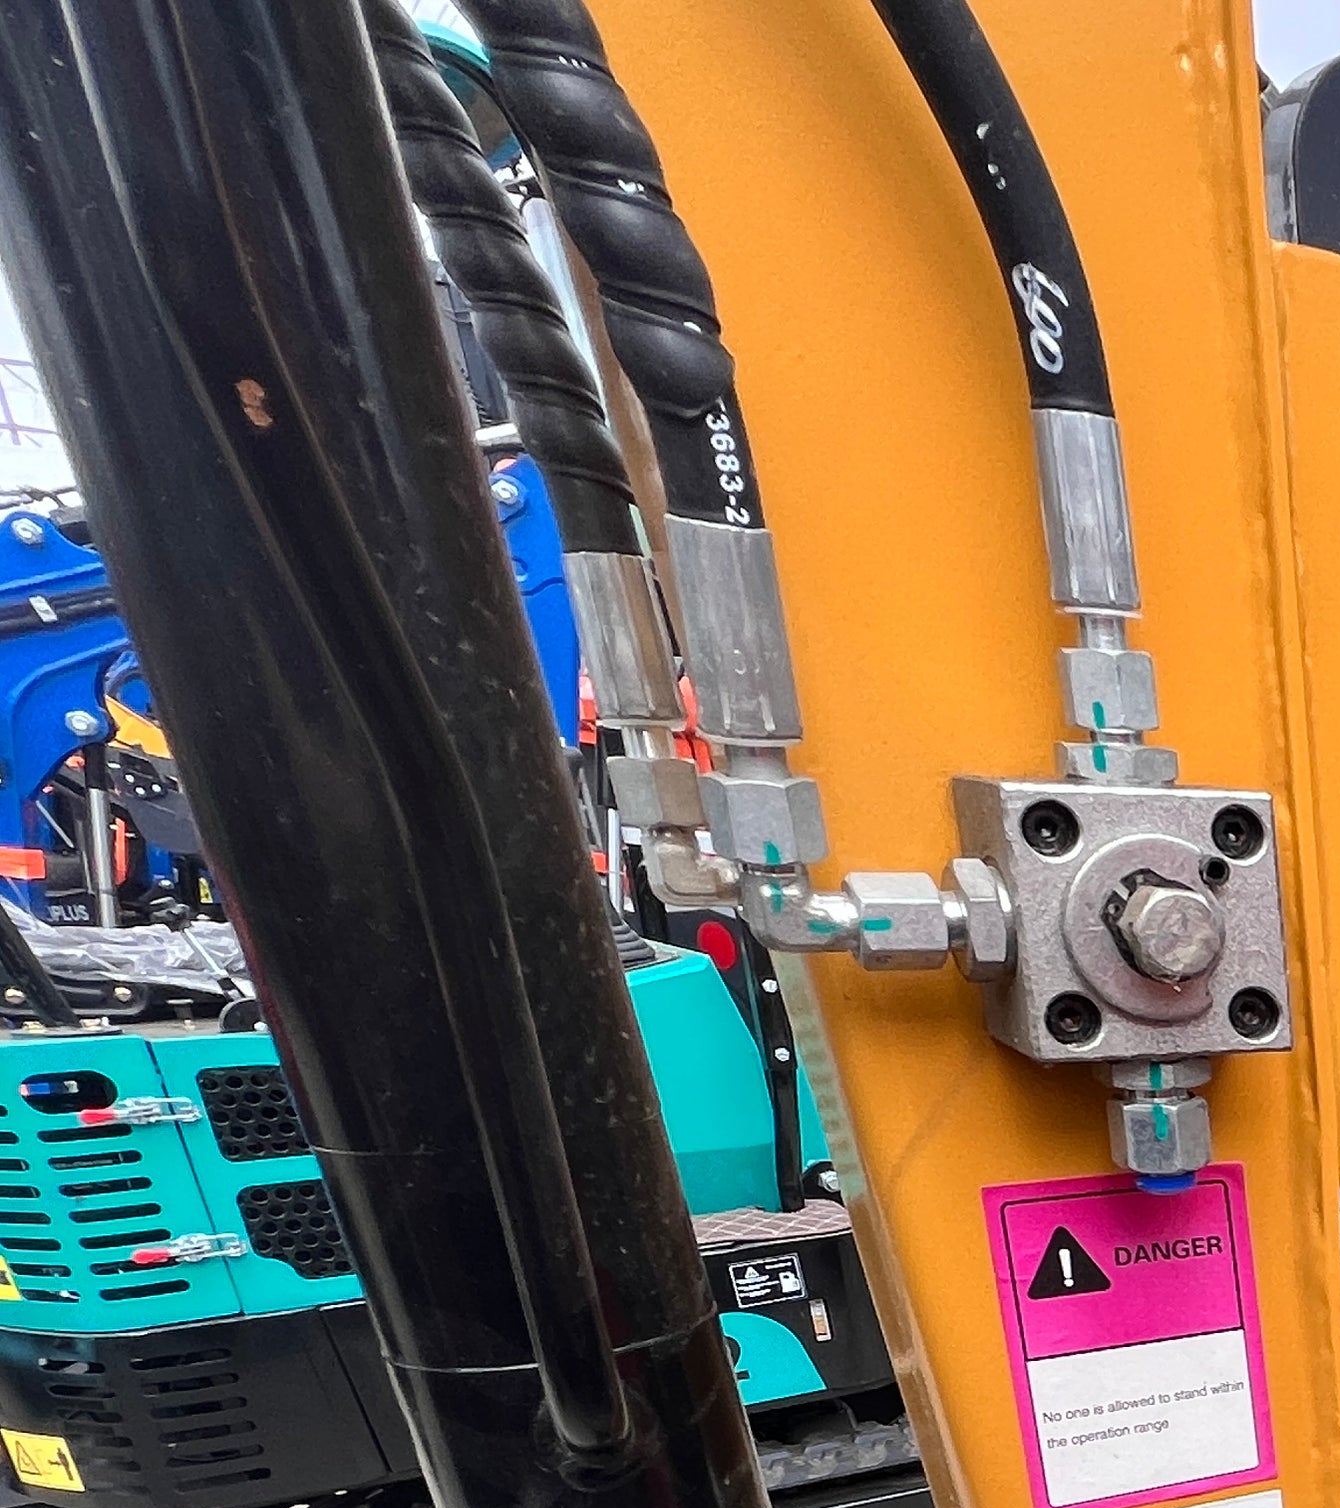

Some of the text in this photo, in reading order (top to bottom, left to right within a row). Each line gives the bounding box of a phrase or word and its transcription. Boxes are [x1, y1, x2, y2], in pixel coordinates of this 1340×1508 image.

[1114, 1235, 1224, 1266] DANGER
[1043, 1380, 1245, 1425] No one is allowed to stand within
[1047, 1418, 1170, 1450] the operation range
